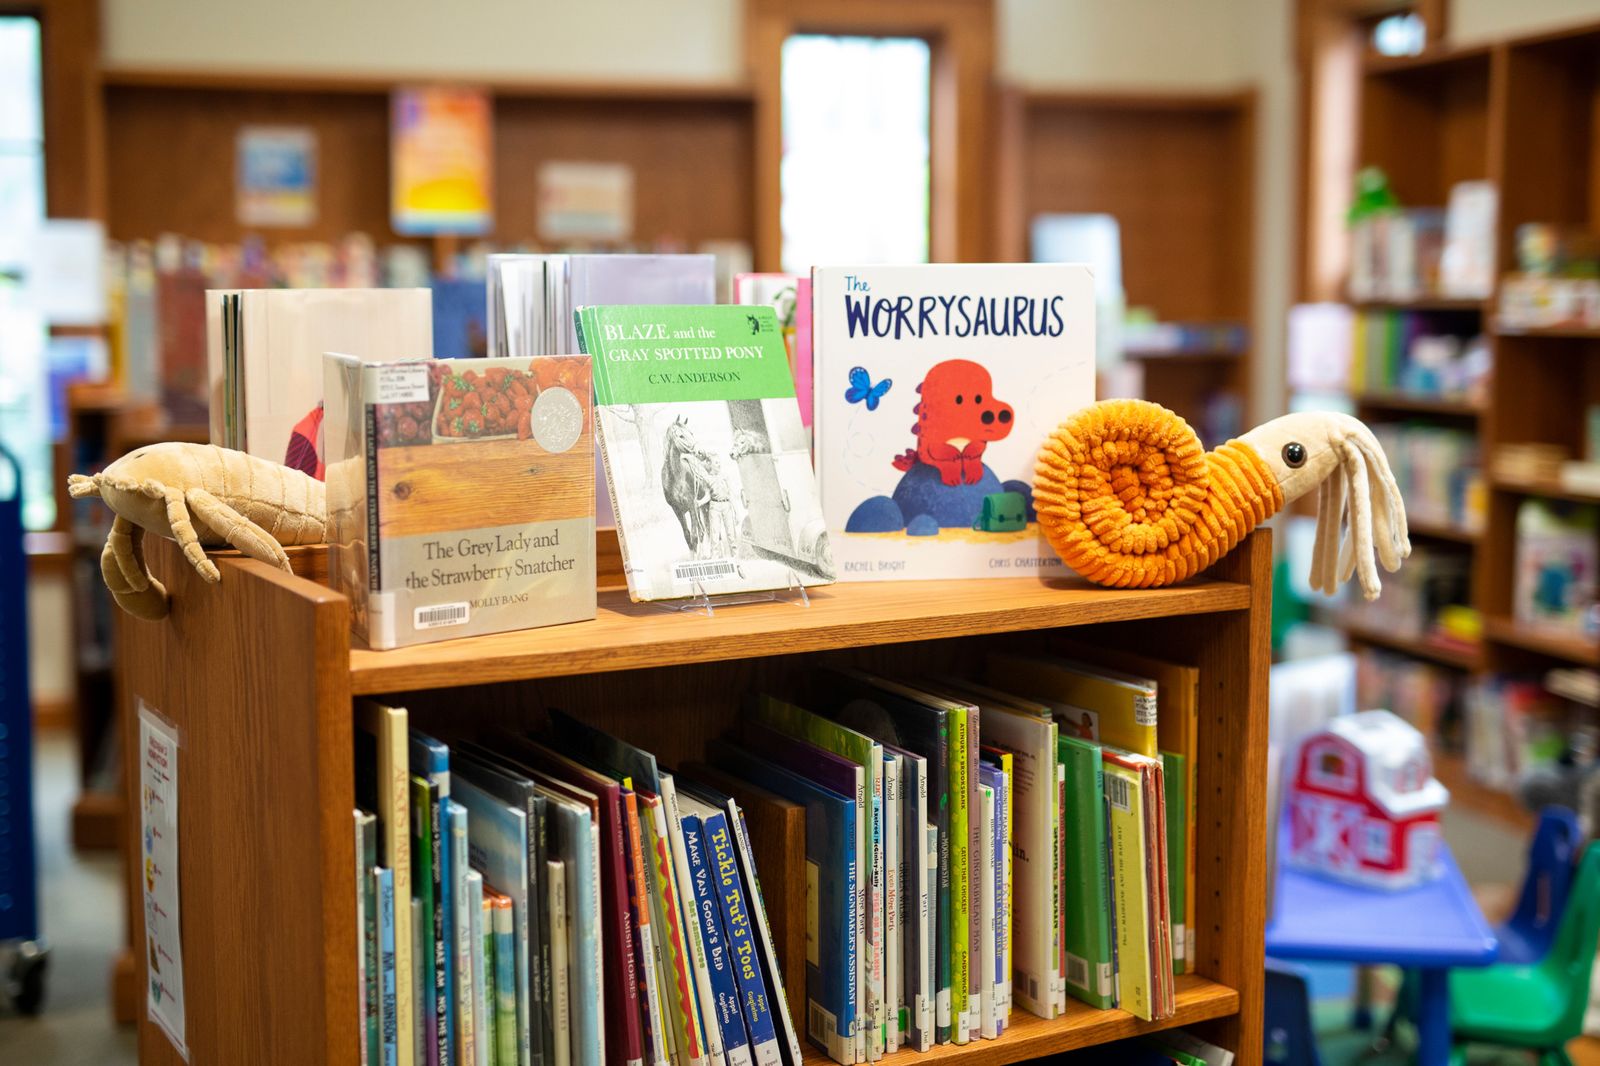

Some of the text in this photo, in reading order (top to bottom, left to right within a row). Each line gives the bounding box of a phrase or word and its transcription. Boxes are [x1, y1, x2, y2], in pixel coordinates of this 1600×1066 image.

[844, 275, 871, 292] The
[844, 295, 1064, 340] WORRYSAURUS
[604, 324, 716, 342] BLAZE and the
[609, 345, 764, 363] GRAY SPOTTED PONY
[676, 372, 741, 383] ANDERSON
[594, 411, 602, 433] BLAZE
[598, 434, 606, 448] AND
[604, 463, 613, 485] GRAY
[609, 487, 620, 518] SPOTTED
[616, 518, 625, 539] PONY
[423, 529, 560, 561] The Grey Lady and
[405, 555, 576, 590] the Strawberry Snatcher
[845, 561, 874, 573] RACHEL
[988, 557, 1011, 569] CHRIS
[469, 592, 529, 609] MOLLY BANG
[887, 776, 895, 801] Arnold
[919, 774, 927, 799] Arnold
[857, 783, 866, 935] Arnold More Parts
[941, 838, 950, 859] MOON
[942, 871, 950, 888] STAR
[685, 831, 724, 971] MAKE VAN GOGH'S BED
[888, 889, 896, 910] More
[973, 850, 981, 933] GINGERBREAD
[712, 828, 756, 979] Tickle Tut's Toes
[873, 916, 880, 929] ON
[888, 911, 896, 932] Parts
[687, 900, 706, 969] Bat Jamboree
[973, 932, 981, 954] MAN
[435, 940, 446, 965] MAE
[624, 911, 637, 1000] AMISH HORSES
[383, 951, 397, 1044] AVA RAINBOW
[718, 992, 730, 1024] Guglielmo
[729, 996, 738, 1014] Appel
[747, 990, 760, 1022] Guglielmo
[757, 994, 767, 1013] Appel
[437, 1015, 448, 1036] THE
